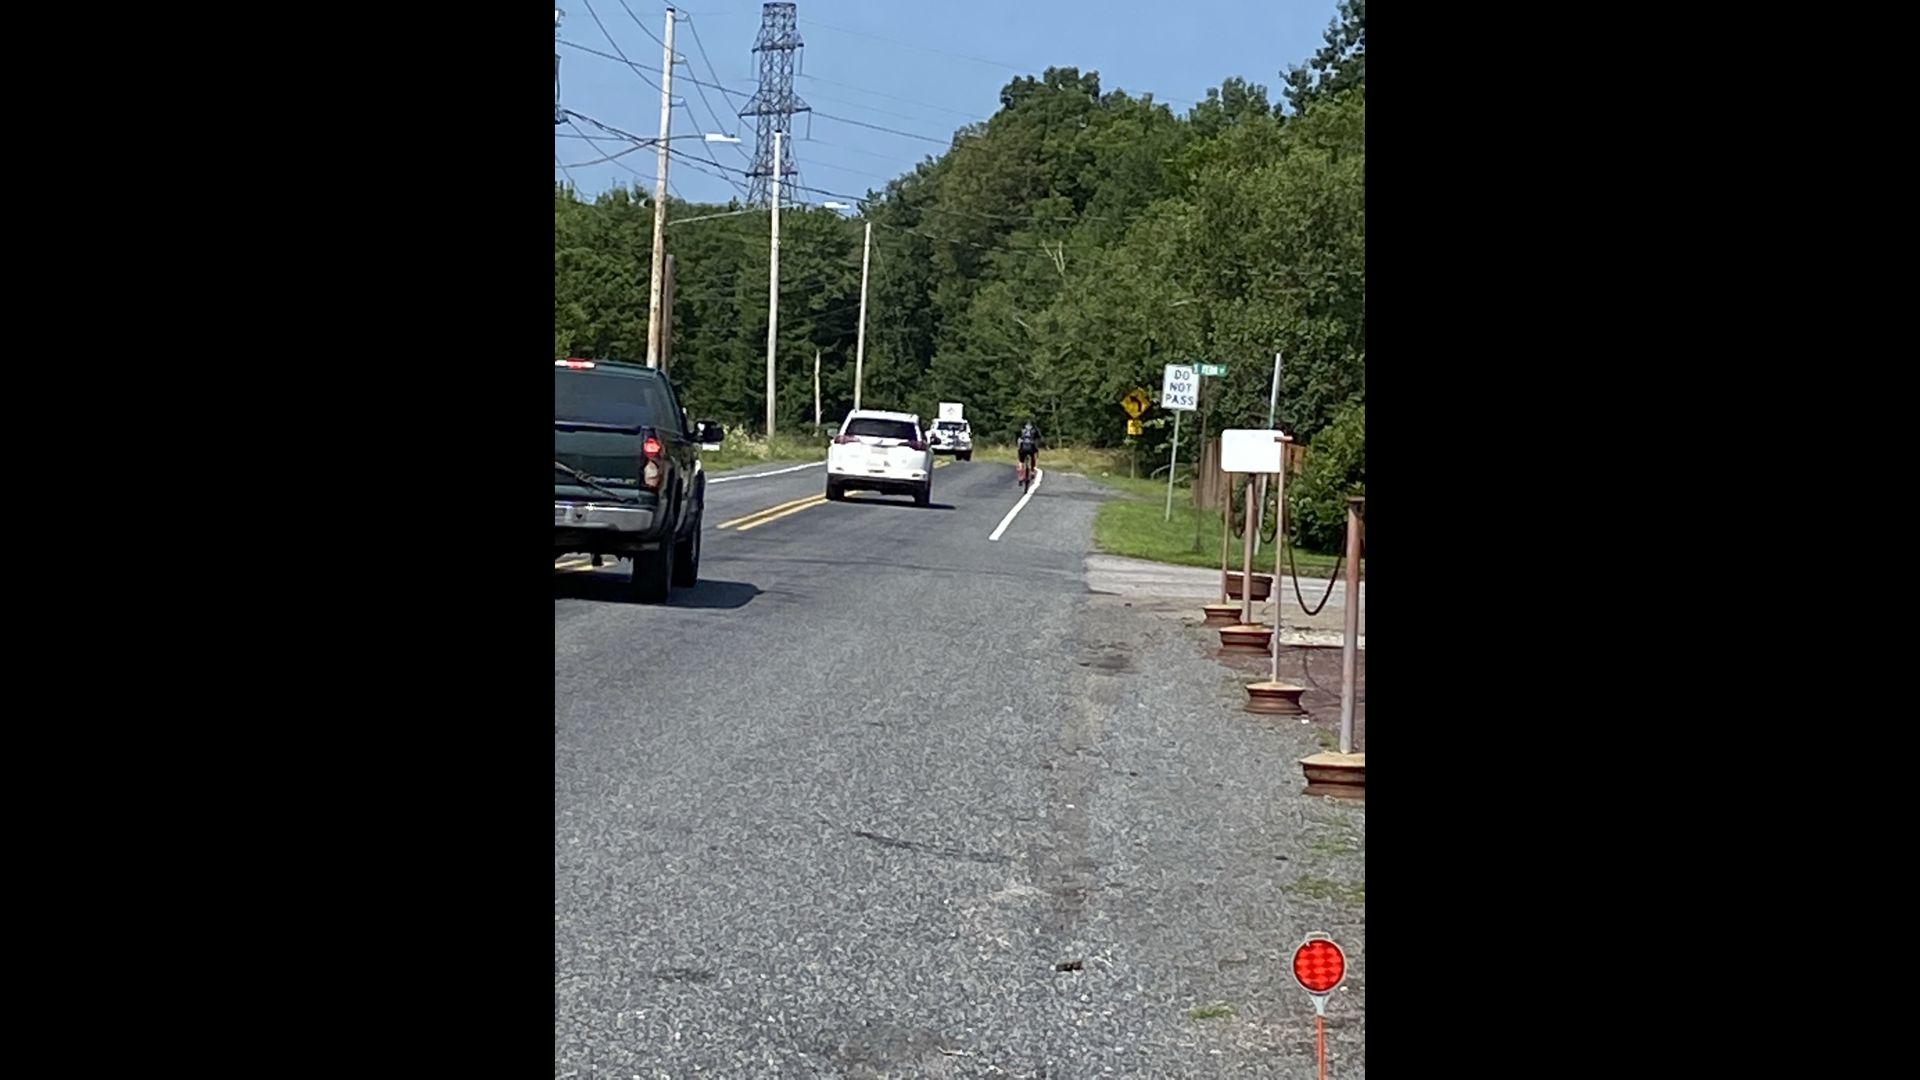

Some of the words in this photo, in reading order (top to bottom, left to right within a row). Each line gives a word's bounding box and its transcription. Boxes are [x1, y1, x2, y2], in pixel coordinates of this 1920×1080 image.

[1174, 369, 1190, 381] DO
[1169, 382, 1192, 393] NOT
[1165, 393, 1194, 406] PASS
